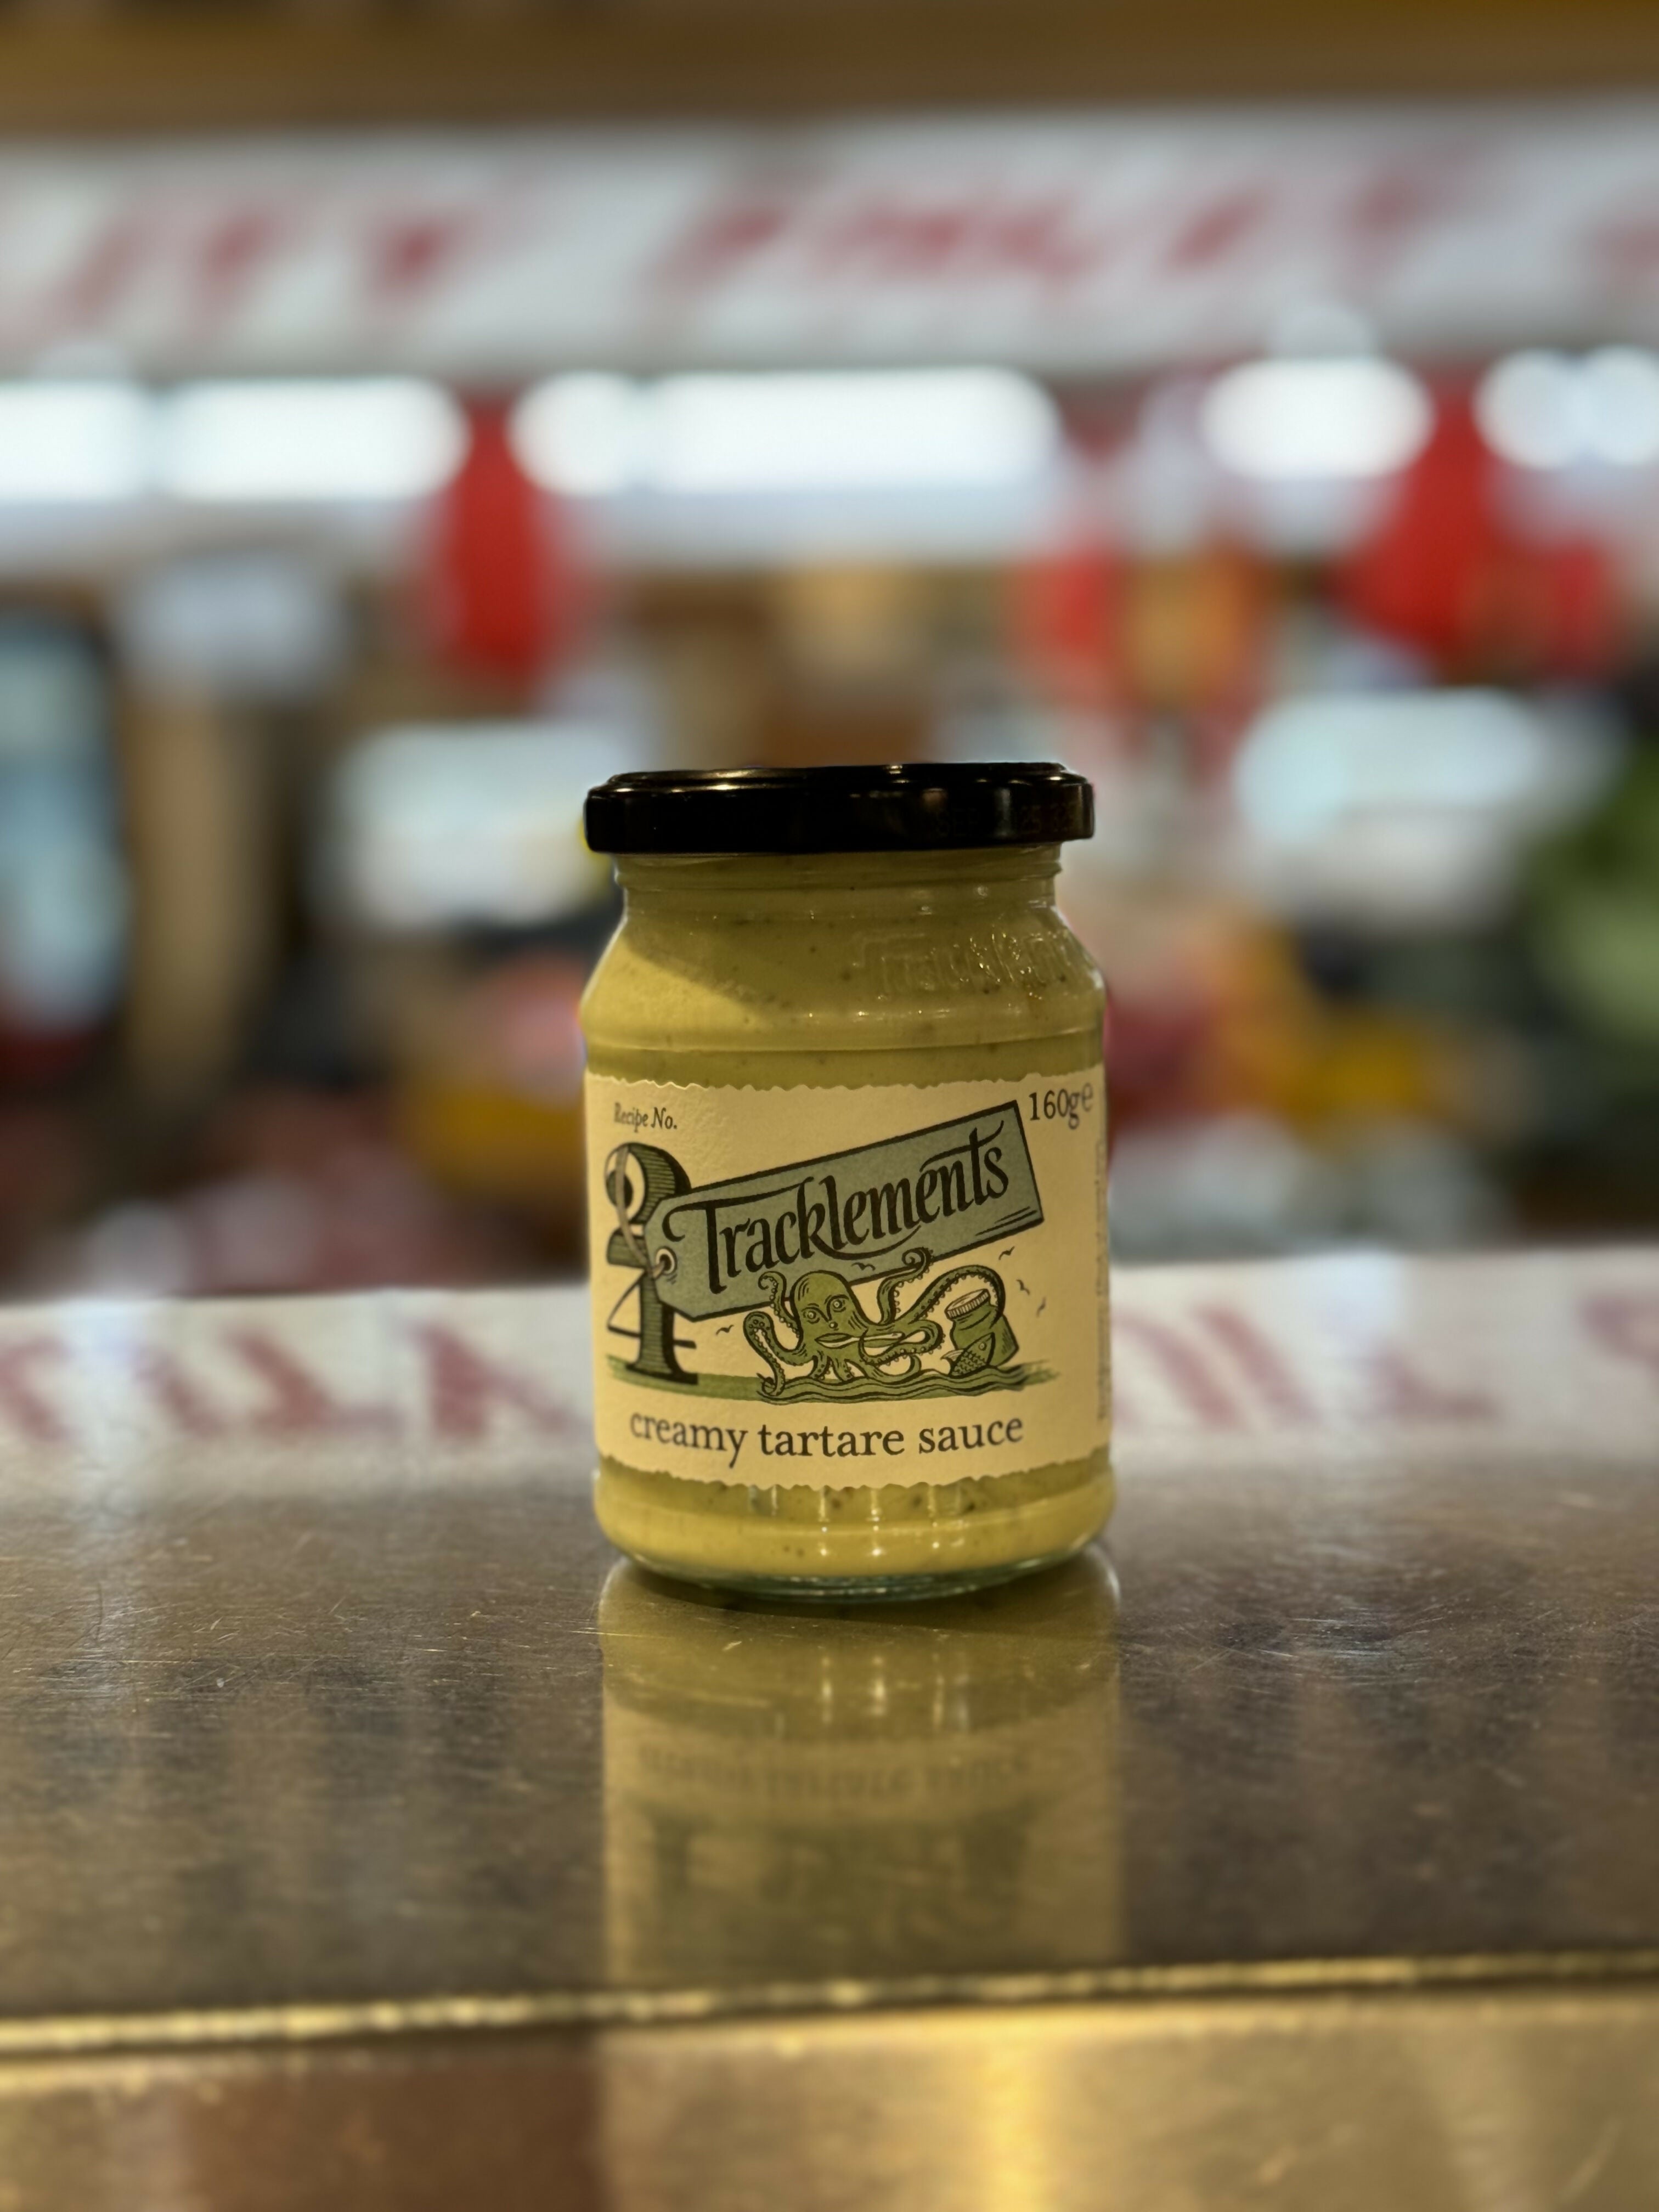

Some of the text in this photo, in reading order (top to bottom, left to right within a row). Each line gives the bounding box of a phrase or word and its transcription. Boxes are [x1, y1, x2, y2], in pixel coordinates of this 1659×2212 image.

[614, 1102, 678, 1133] Recipe No.
[662, 1120, 1009, 1295] Tracklements
[630, 1412, 1024, 1469] creamy tartare sauce
